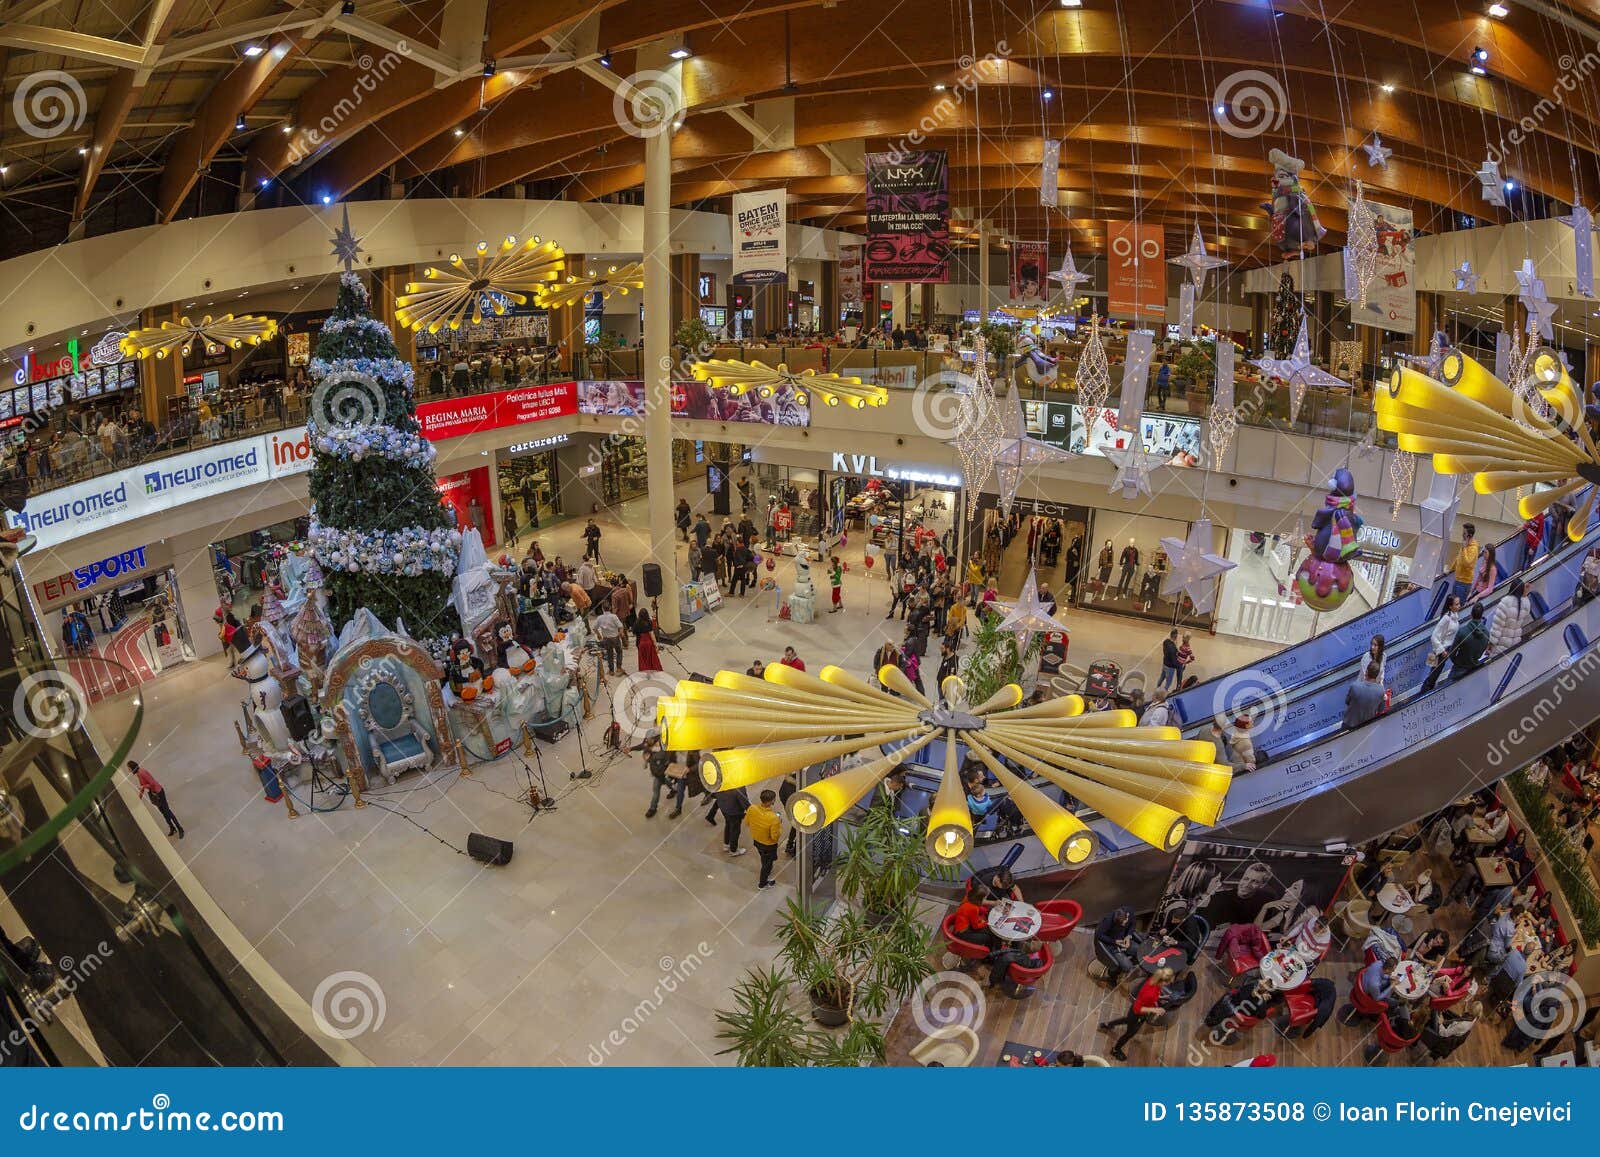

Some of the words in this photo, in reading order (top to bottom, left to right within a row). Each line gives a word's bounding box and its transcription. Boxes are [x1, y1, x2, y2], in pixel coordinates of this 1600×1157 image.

[887, 167, 924, 180] NYX
[738, 202, 779, 223] BATEM
[425, 411, 459, 425] REGINA
[460, 405, 487, 418] MARIA
[162, 447, 258, 489] neuromed
[832, 452, 884, 476] KVL
[889, 469, 899, 480] by
[30, 482, 128, 530] neuromed
[1286, 755, 1321, 775] IQOS
[1325, 751, 1333, 760] 3
